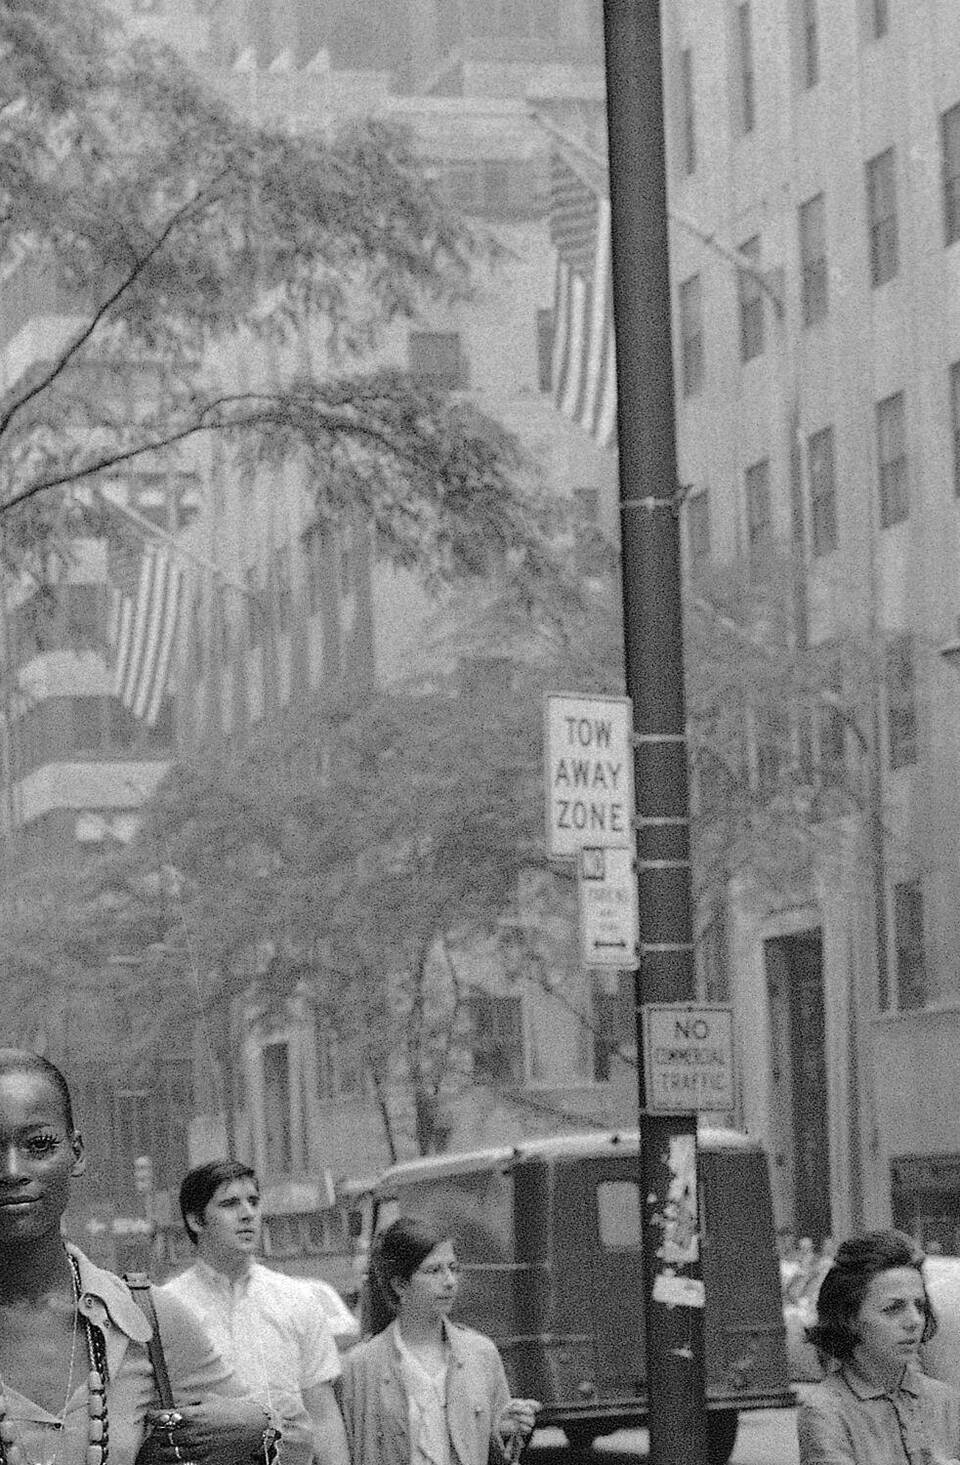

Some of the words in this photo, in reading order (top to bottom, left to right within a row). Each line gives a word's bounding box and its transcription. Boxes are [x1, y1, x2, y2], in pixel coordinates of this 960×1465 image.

[565, 716, 613, 748] TOW
[554, 758, 623, 791] AWAY
[556, 800, 623, 832] ZONE
[674, 1019, 710, 1040] NO
[658, 1072, 727, 1091] TRAFFIC
